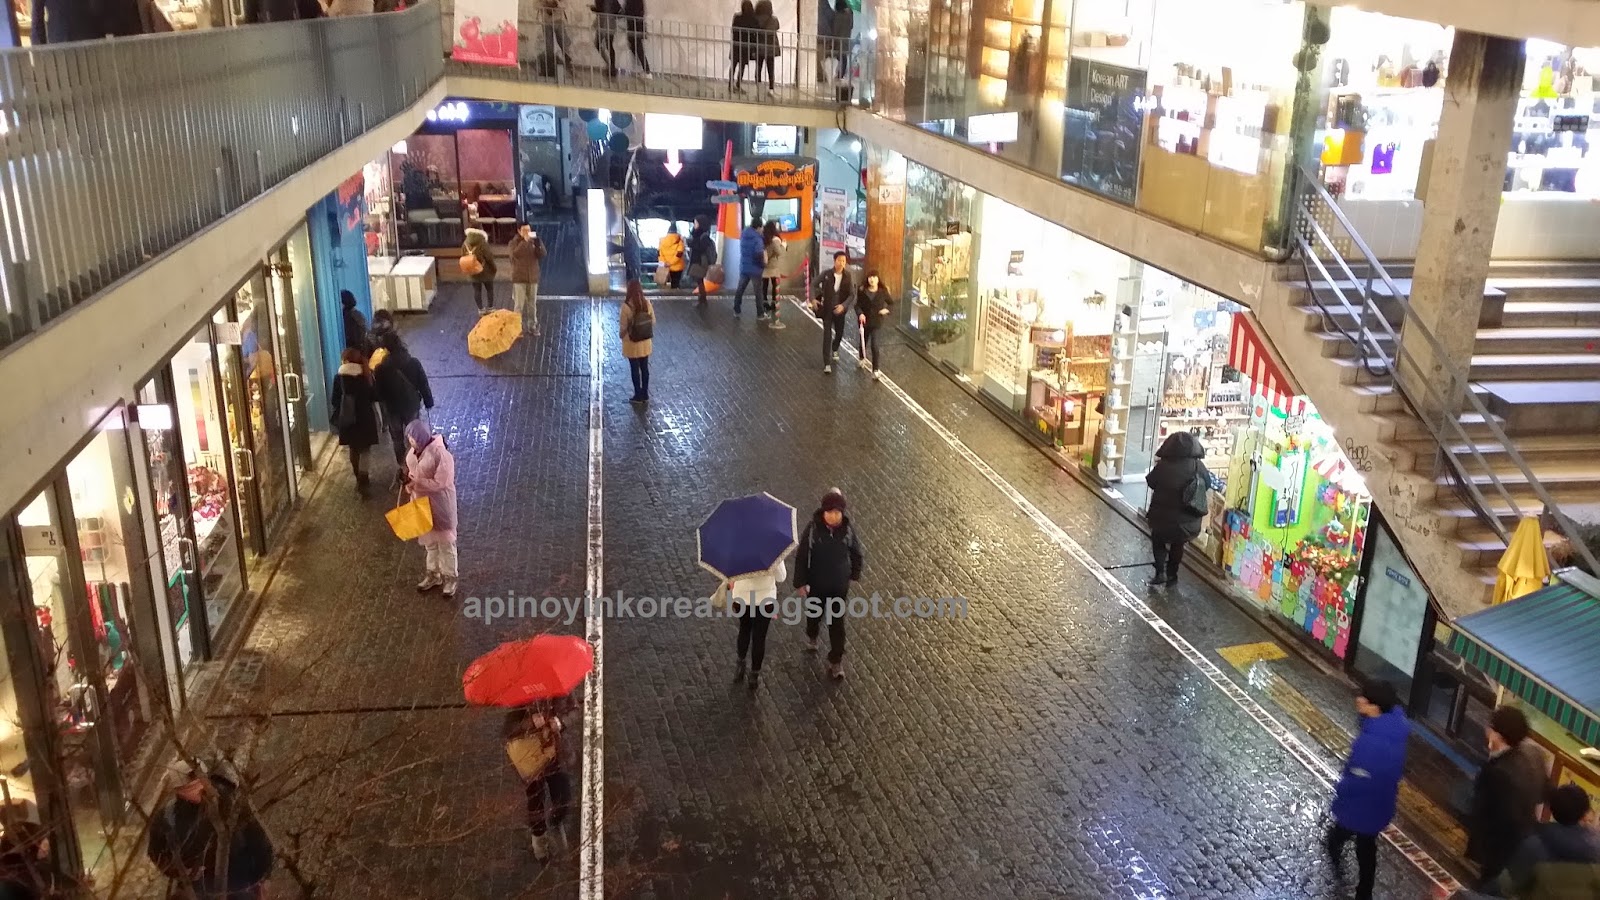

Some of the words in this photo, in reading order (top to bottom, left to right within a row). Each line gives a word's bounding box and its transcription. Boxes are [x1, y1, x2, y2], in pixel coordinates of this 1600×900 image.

[1092, 69, 1114, 86] Korean
[1115, 74, 1129, 90] ART
[1090, 88, 1112, 107] Design
